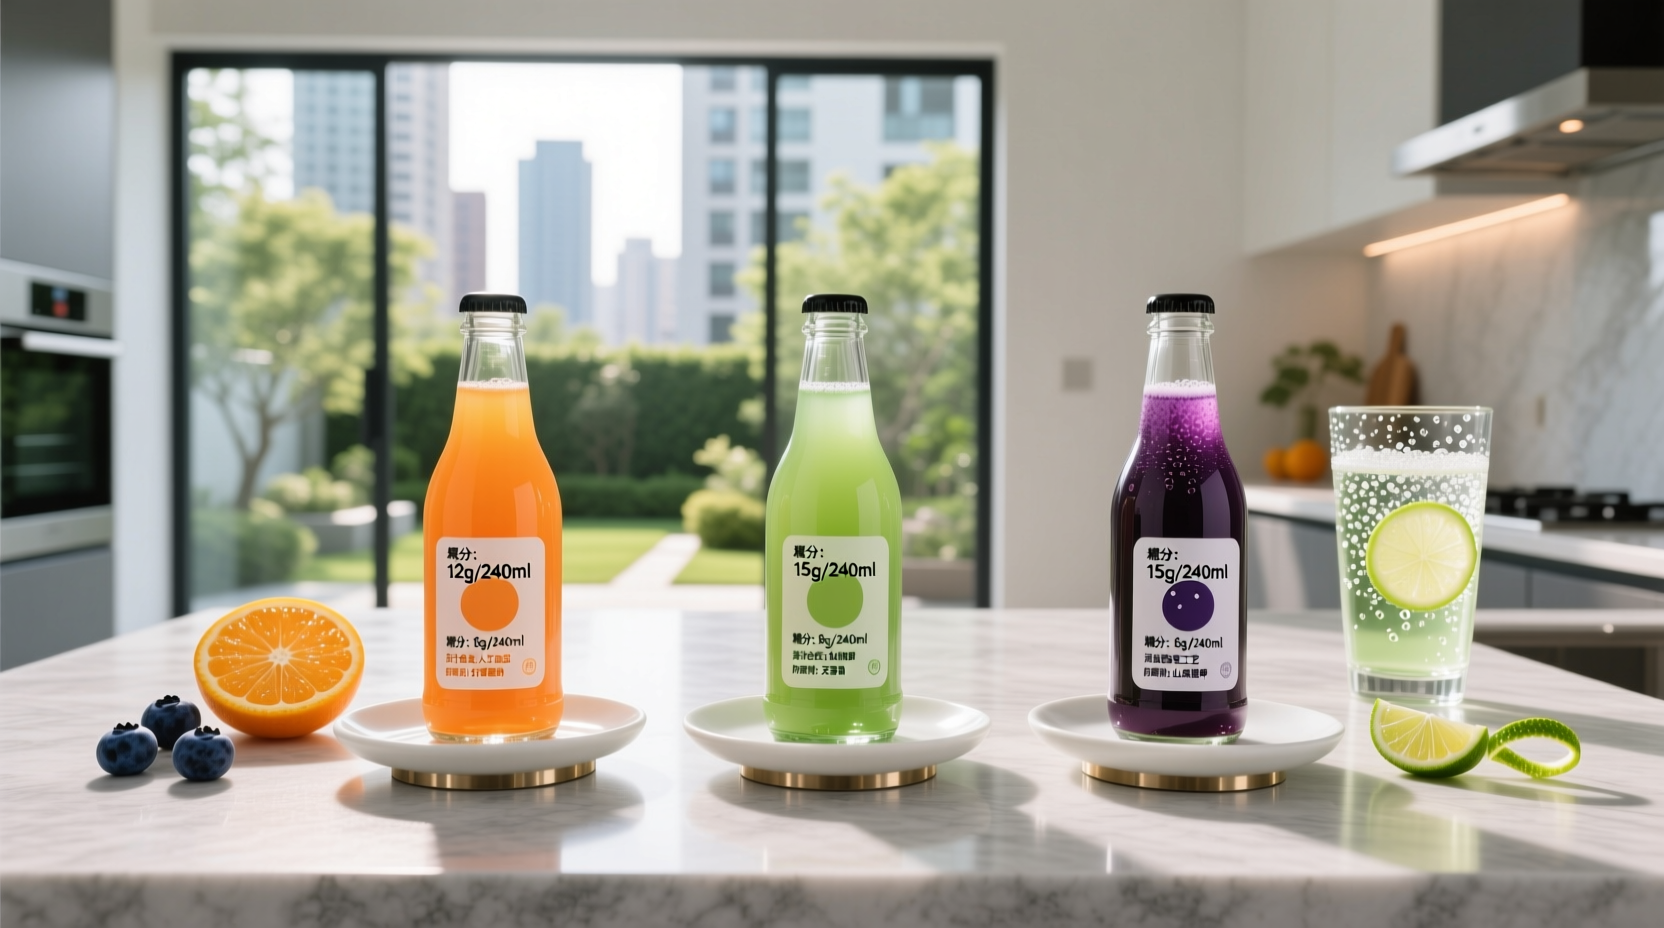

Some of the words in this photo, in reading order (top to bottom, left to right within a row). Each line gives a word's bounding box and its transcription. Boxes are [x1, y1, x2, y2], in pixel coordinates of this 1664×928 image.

[447, 562, 531, 584] 12g/240ml
[794, 561, 876, 582] 15g/240ml
[1147, 564, 1228, 584] 15g/240ml
